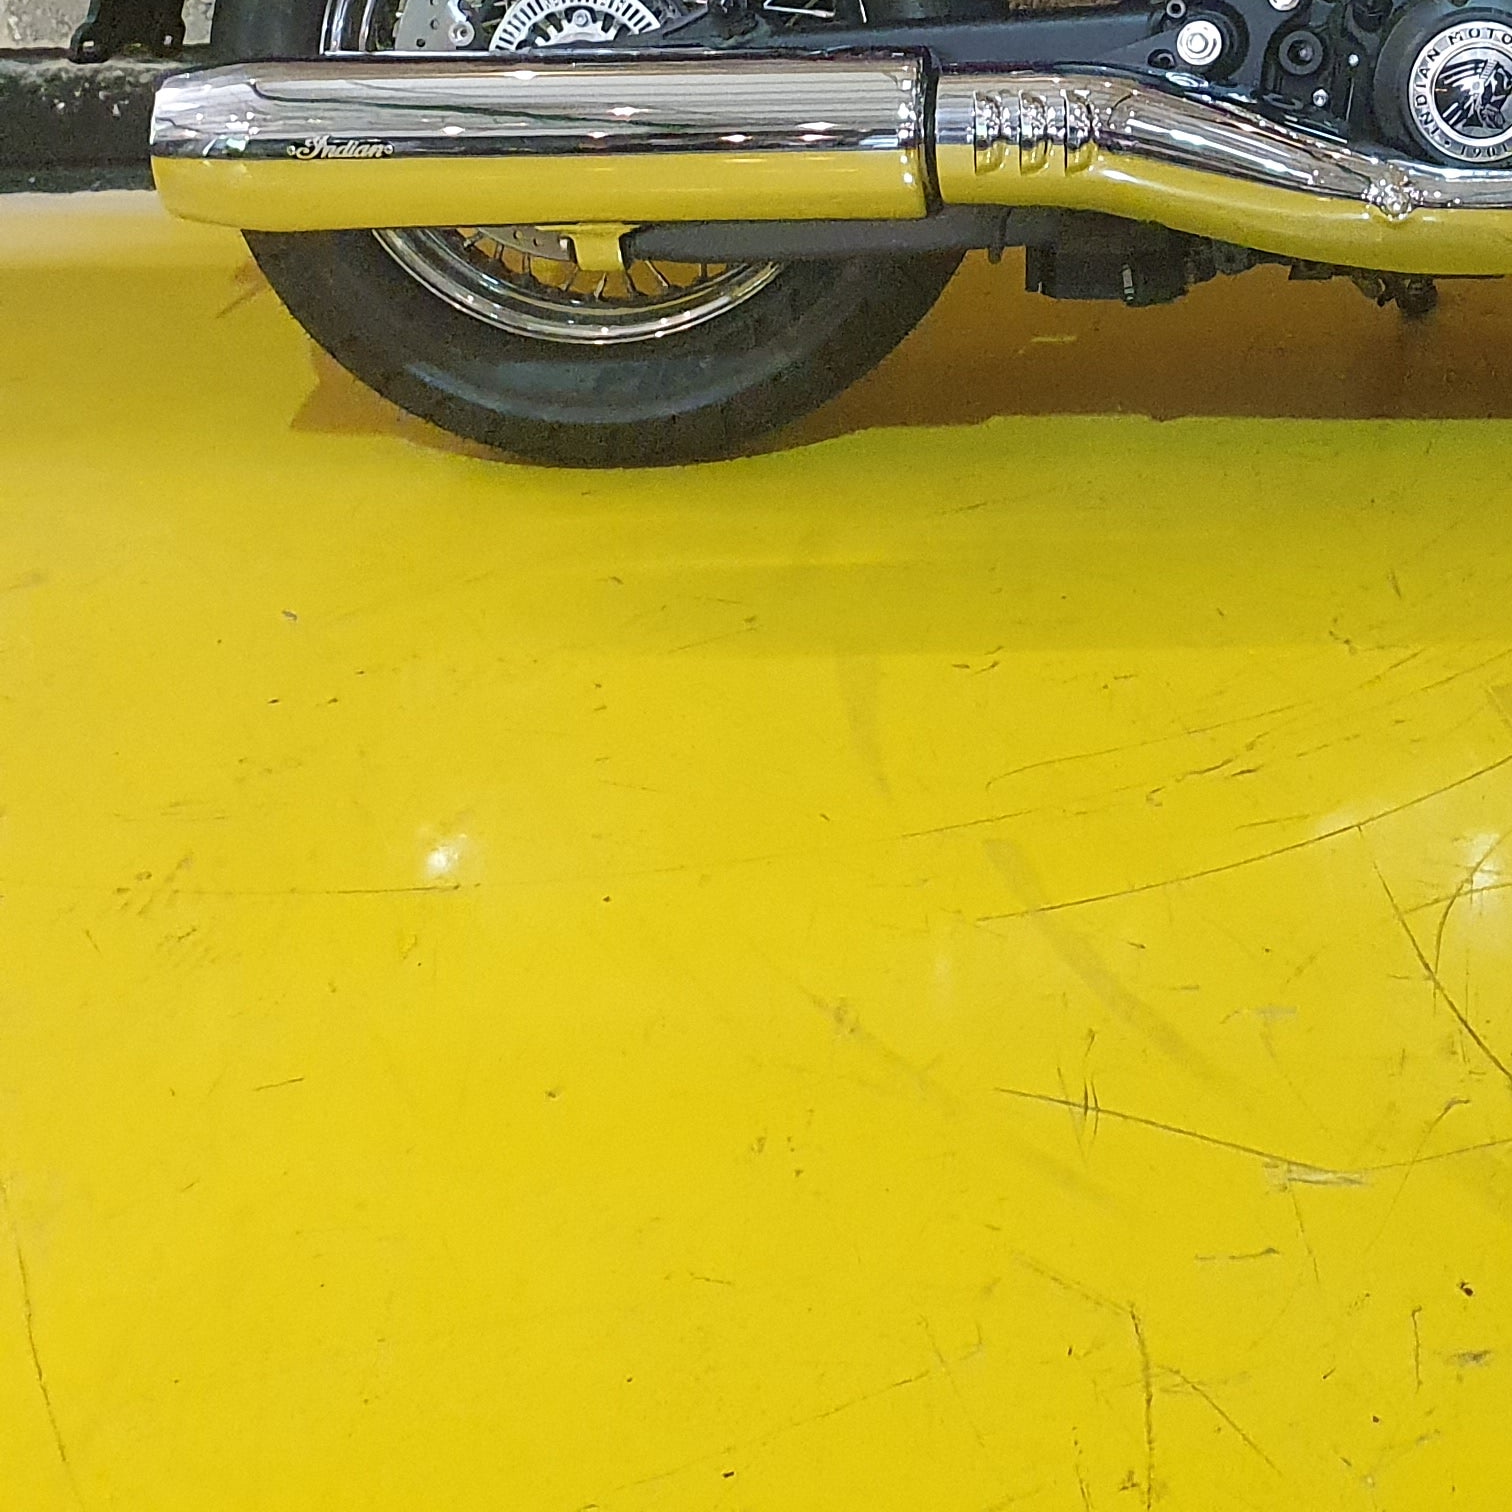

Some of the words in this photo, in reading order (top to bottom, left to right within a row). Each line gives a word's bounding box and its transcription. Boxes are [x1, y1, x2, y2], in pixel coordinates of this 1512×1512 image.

[1415, 47, 1441, 136] INDIAN
[295, 134, 385, 160] Indian
[1461, 144, 1508, 158] 1901
